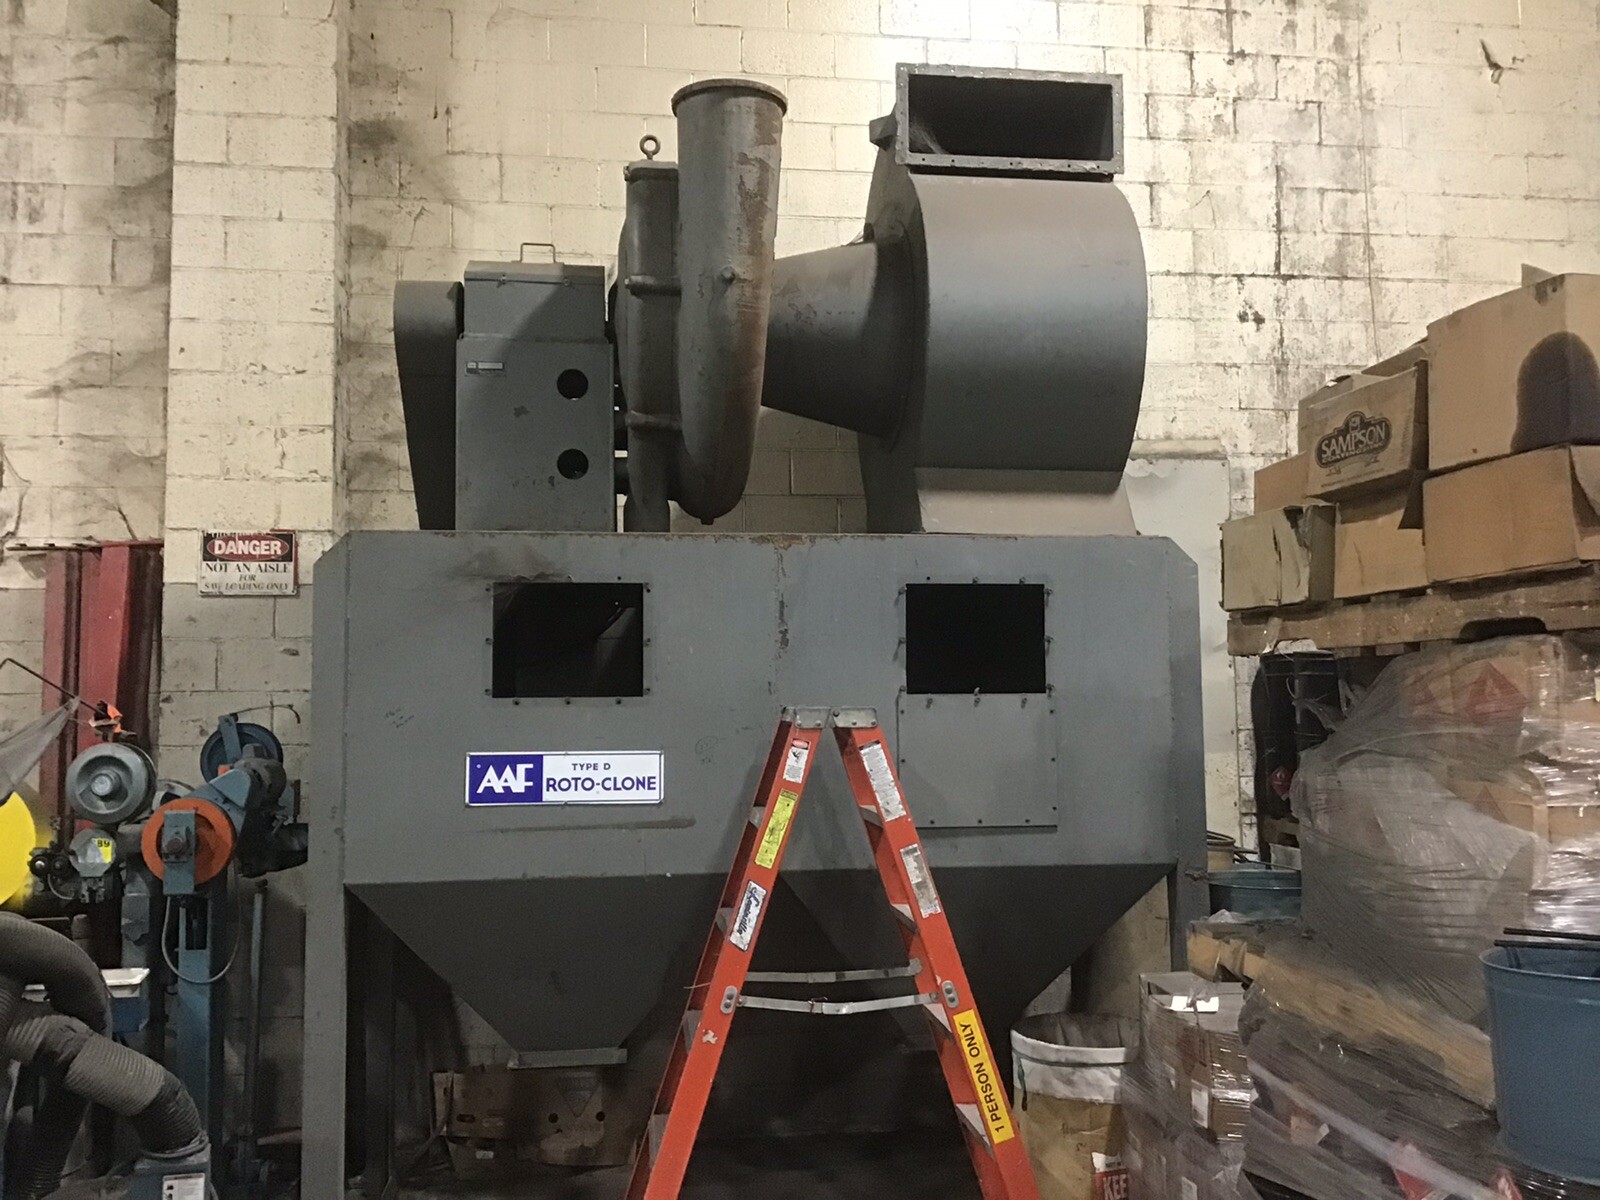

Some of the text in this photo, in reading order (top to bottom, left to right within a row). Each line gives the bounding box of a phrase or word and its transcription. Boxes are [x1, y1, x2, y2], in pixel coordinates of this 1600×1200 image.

[1321, 422, 1386, 458] SAMPSON
[214, 540, 281, 555] DANGER
[206, 563, 289, 573] NOT AN AISLE
[225, 582, 263, 591] LOADING
[266, 582, 289, 591] ONLY
[571, 763, 611, 771] TYPE D
[476, 763, 534, 793] AAF
[545, 776, 657, 792] ROTO-CLONE
[960, 1023, 1005, 1133] 1 PERSON ONLY
